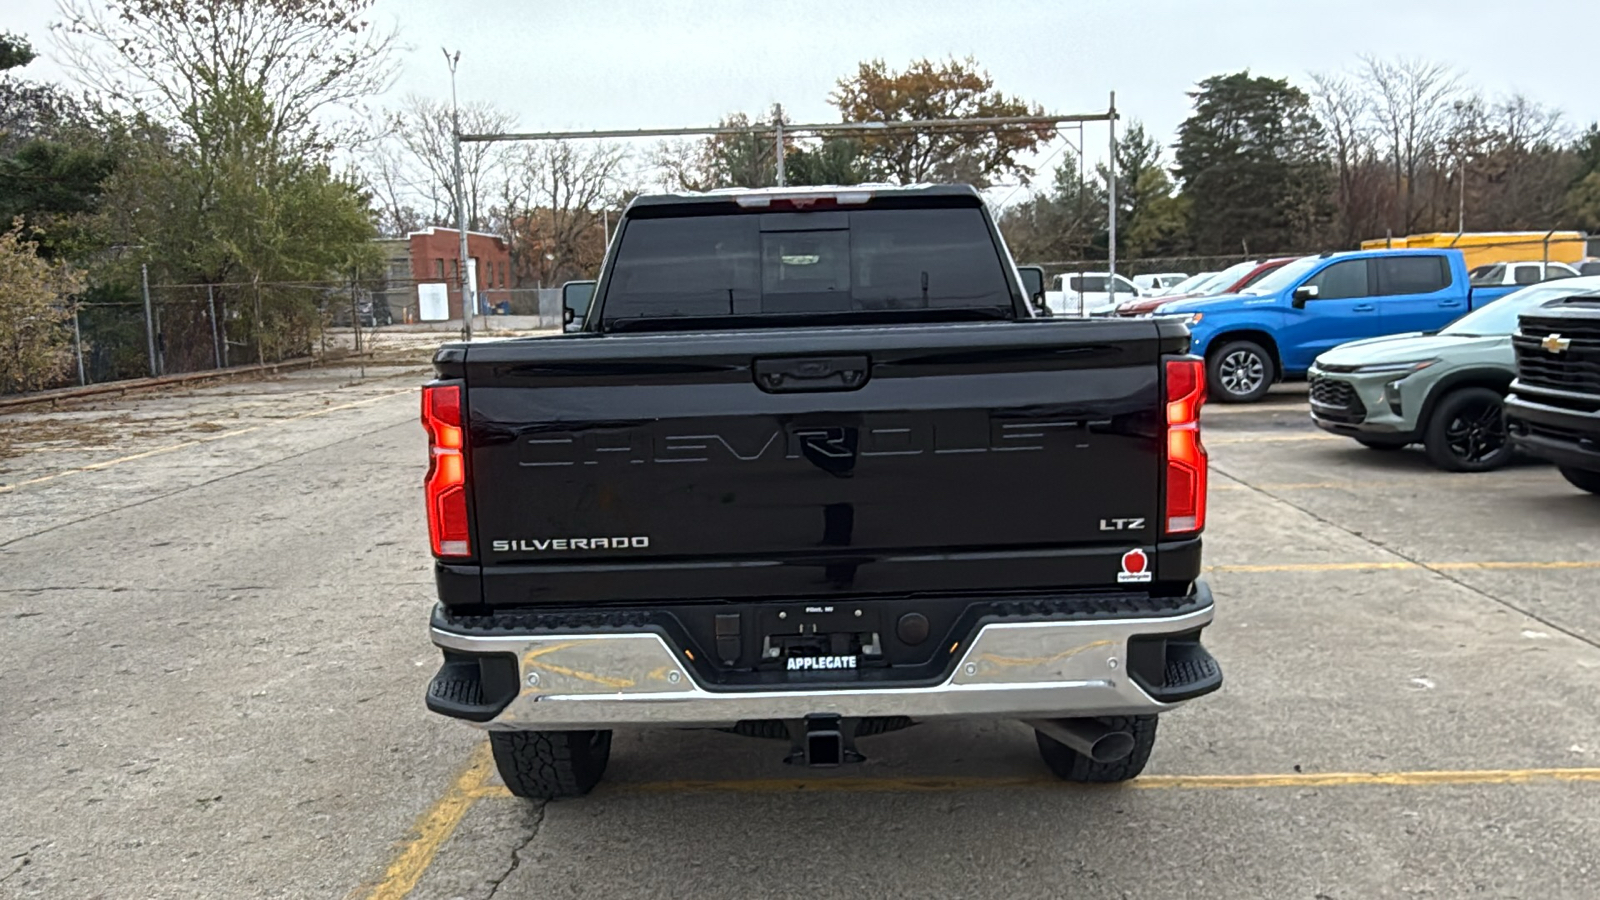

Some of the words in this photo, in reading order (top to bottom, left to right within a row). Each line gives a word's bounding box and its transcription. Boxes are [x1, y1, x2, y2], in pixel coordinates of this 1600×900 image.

[518, 420, 1113, 466] CHEVROLET
[1100, 518, 1145, 530] LTZ
[492, 536, 649, 551] SILVERADO
[787, 656, 857, 670] APPLEGATE
